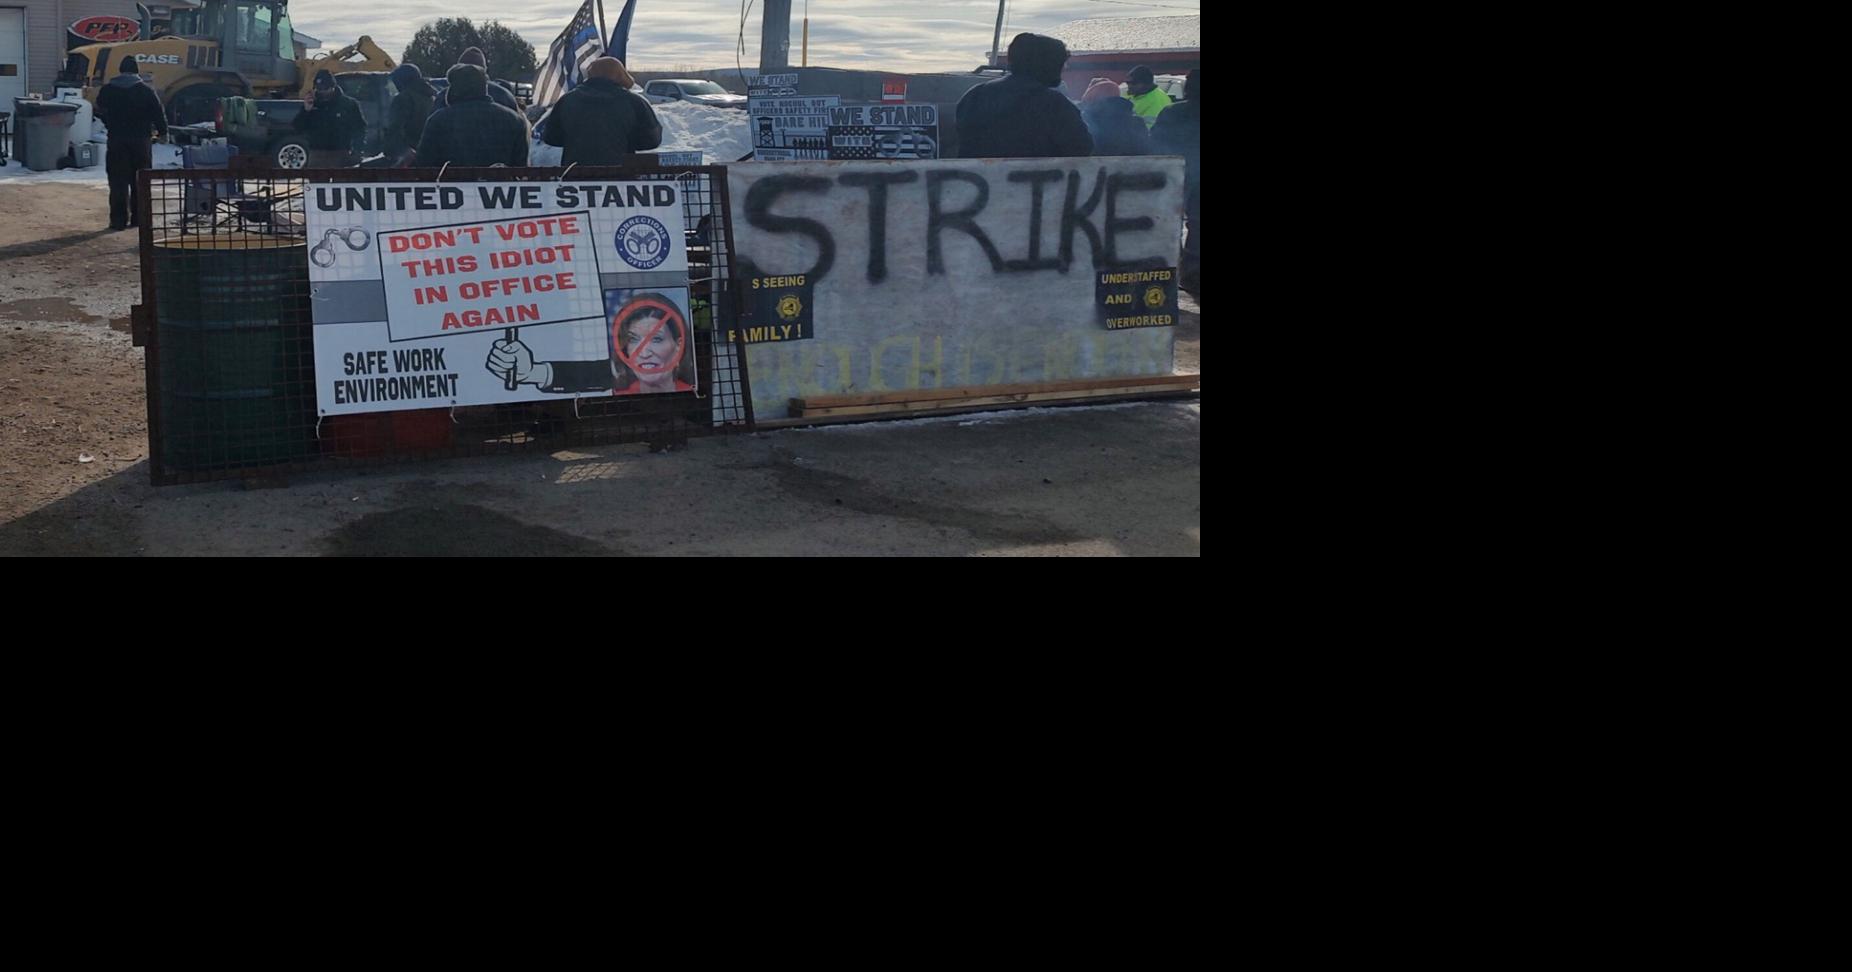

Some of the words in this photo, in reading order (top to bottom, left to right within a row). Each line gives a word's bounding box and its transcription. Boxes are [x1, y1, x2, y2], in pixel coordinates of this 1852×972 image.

[135, 53, 180, 64] CASE
[809, 117, 828, 128] HIL
[830, 107, 864, 125] WE
[870, 105, 935, 124] STAND
[316, 186, 464, 212] UNITED
[478, 185, 543, 210] WE
[556, 184, 676, 208] STAND
[388, 226, 484, 253] DON'T
[495, 216, 580, 241] VOTE
[617, 216, 668, 240] CORRECTIONS
[735, 166, 1168, 285] STRIKE
[401, 254, 478, 278] THIS
[489, 244, 575, 270] IDIOT
[626, 256, 663, 268] OFFICER
[414, 286, 449, 305] IN
[459, 272, 577, 300] OFFICE
[763, 275, 805, 289] SEEING
[1102, 270, 1171, 284] UNDERSTAFFED
[1104, 294, 1132, 305] AND
[441, 303, 540, 330] AGAIN
[1106, 314, 1172, 329] OVERWORKED
[343, 351, 388, 376] SAFE
[394, 348, 447, 373] WORK
[334, 373, 459, 404] ENVIRONMENT
